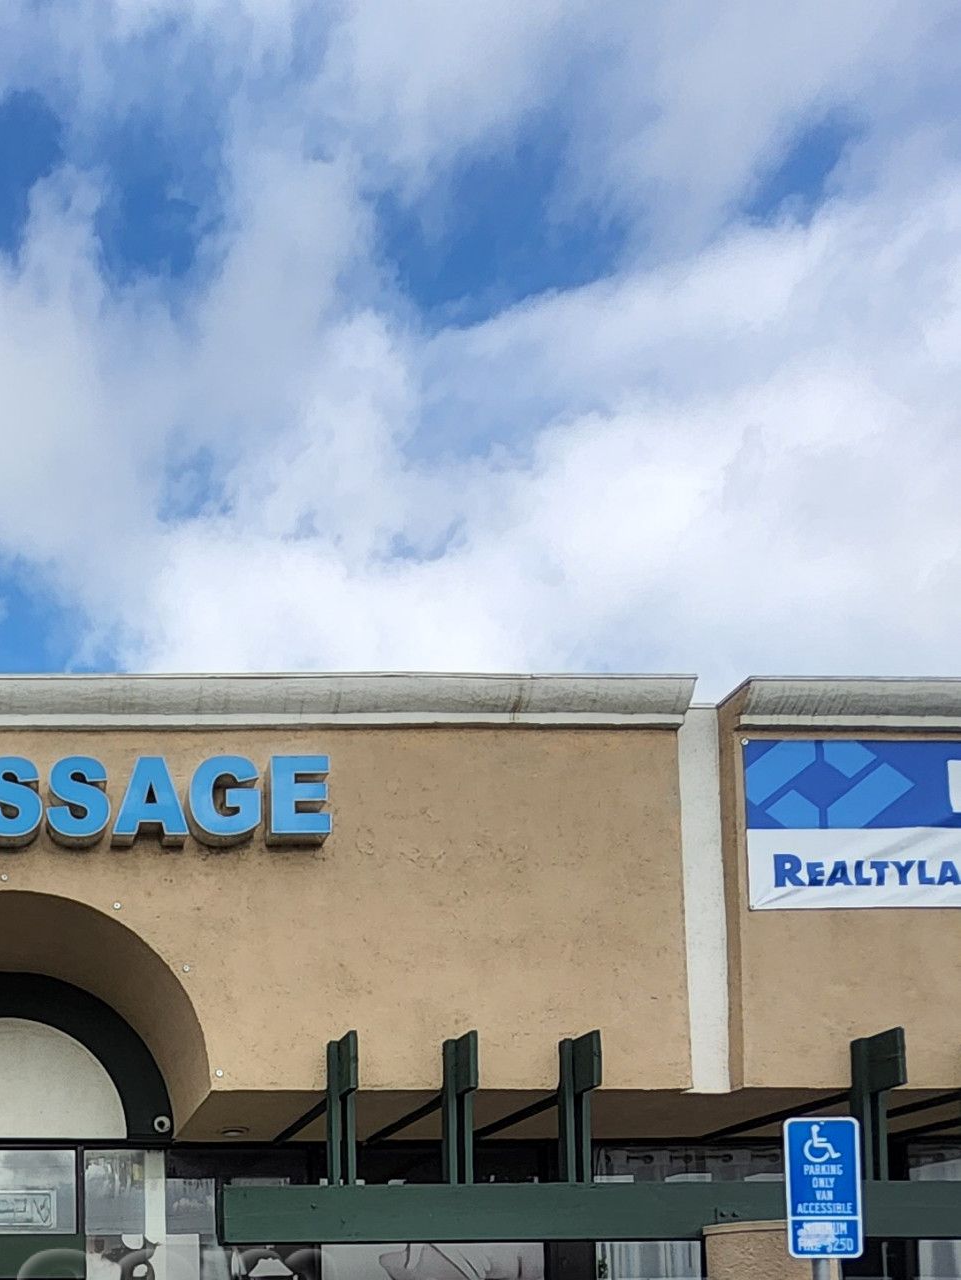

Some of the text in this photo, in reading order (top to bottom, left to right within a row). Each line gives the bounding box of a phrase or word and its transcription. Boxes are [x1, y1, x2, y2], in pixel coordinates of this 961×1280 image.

[803, 1164, 844, 1175] PARKING
[812, 1177, 836, 1188] ONLY
[815, 1190, 834, 1201] VAN
[796, 1203, 853, 1214] ACCESSIBLE
